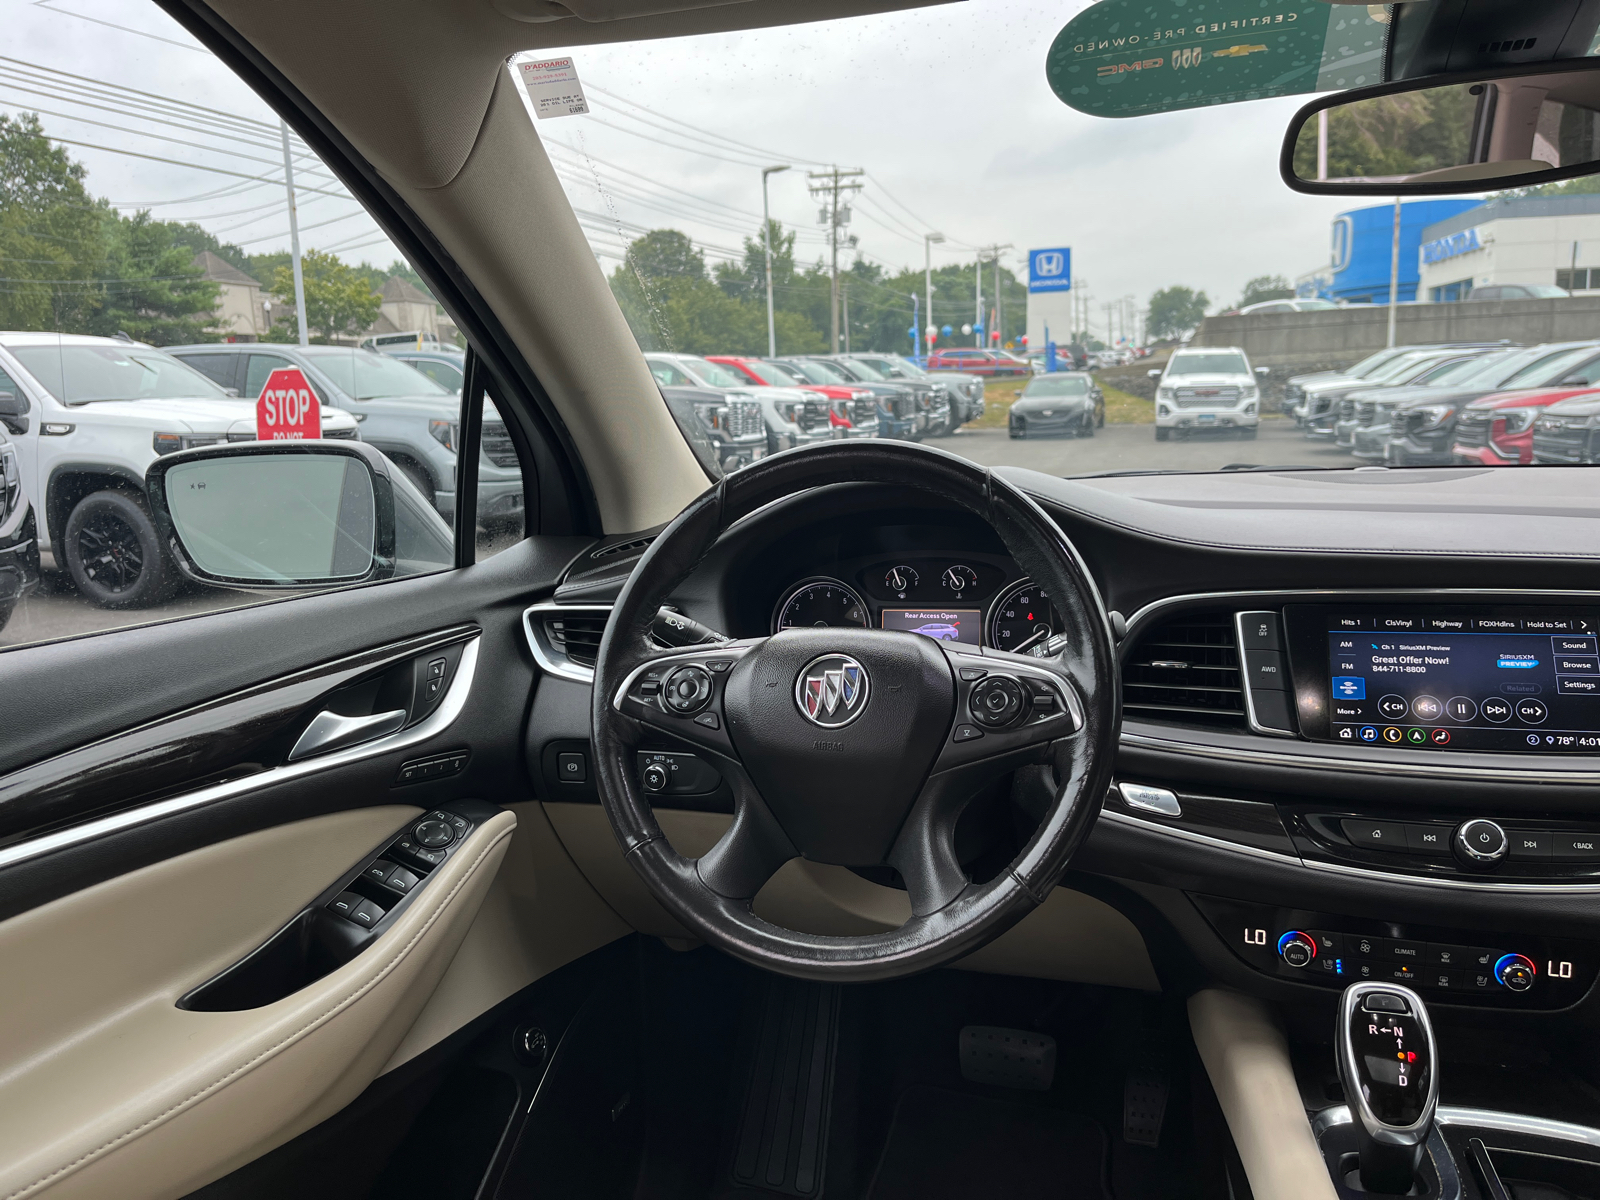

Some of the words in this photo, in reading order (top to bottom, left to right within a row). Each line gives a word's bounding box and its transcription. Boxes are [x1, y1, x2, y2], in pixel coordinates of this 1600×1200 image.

[524, 60, 569, 70] D'ADDARIO
[1423, 228, 1482, 264] HONDA
[265, 388, 310, 426] STOP
[1020, 596, 1029, 604] 60
[941, 612, 958, 620] Open
[1385, 619, 1413, 628] ClsVinyl
[1432, 620, 1463, 629] Highway
[1554, 621, 1567, 629] Set
[1002, 630, 1011, 638] 20
[1372, 655, 1397, 664] Great
[1399, 655, 1423, 664] Offer
[1425, 656, 1449, 665] Now!
[1564, 681, 1596, 691] Settings
[1556, 736, 1575, 745] 78°
[812, 741, 844, 751] AIRBAG
[1577, 841, 1594, 850] BACK
[1394, 948, 1416, 956] CLIMATE
[1368, 1024, 1379, 1035] R
[1393, 1026, 1404, 1037] N
[1407, 1051, 1417, 1063] P
[1398, 1075, 1408, 1087] D
